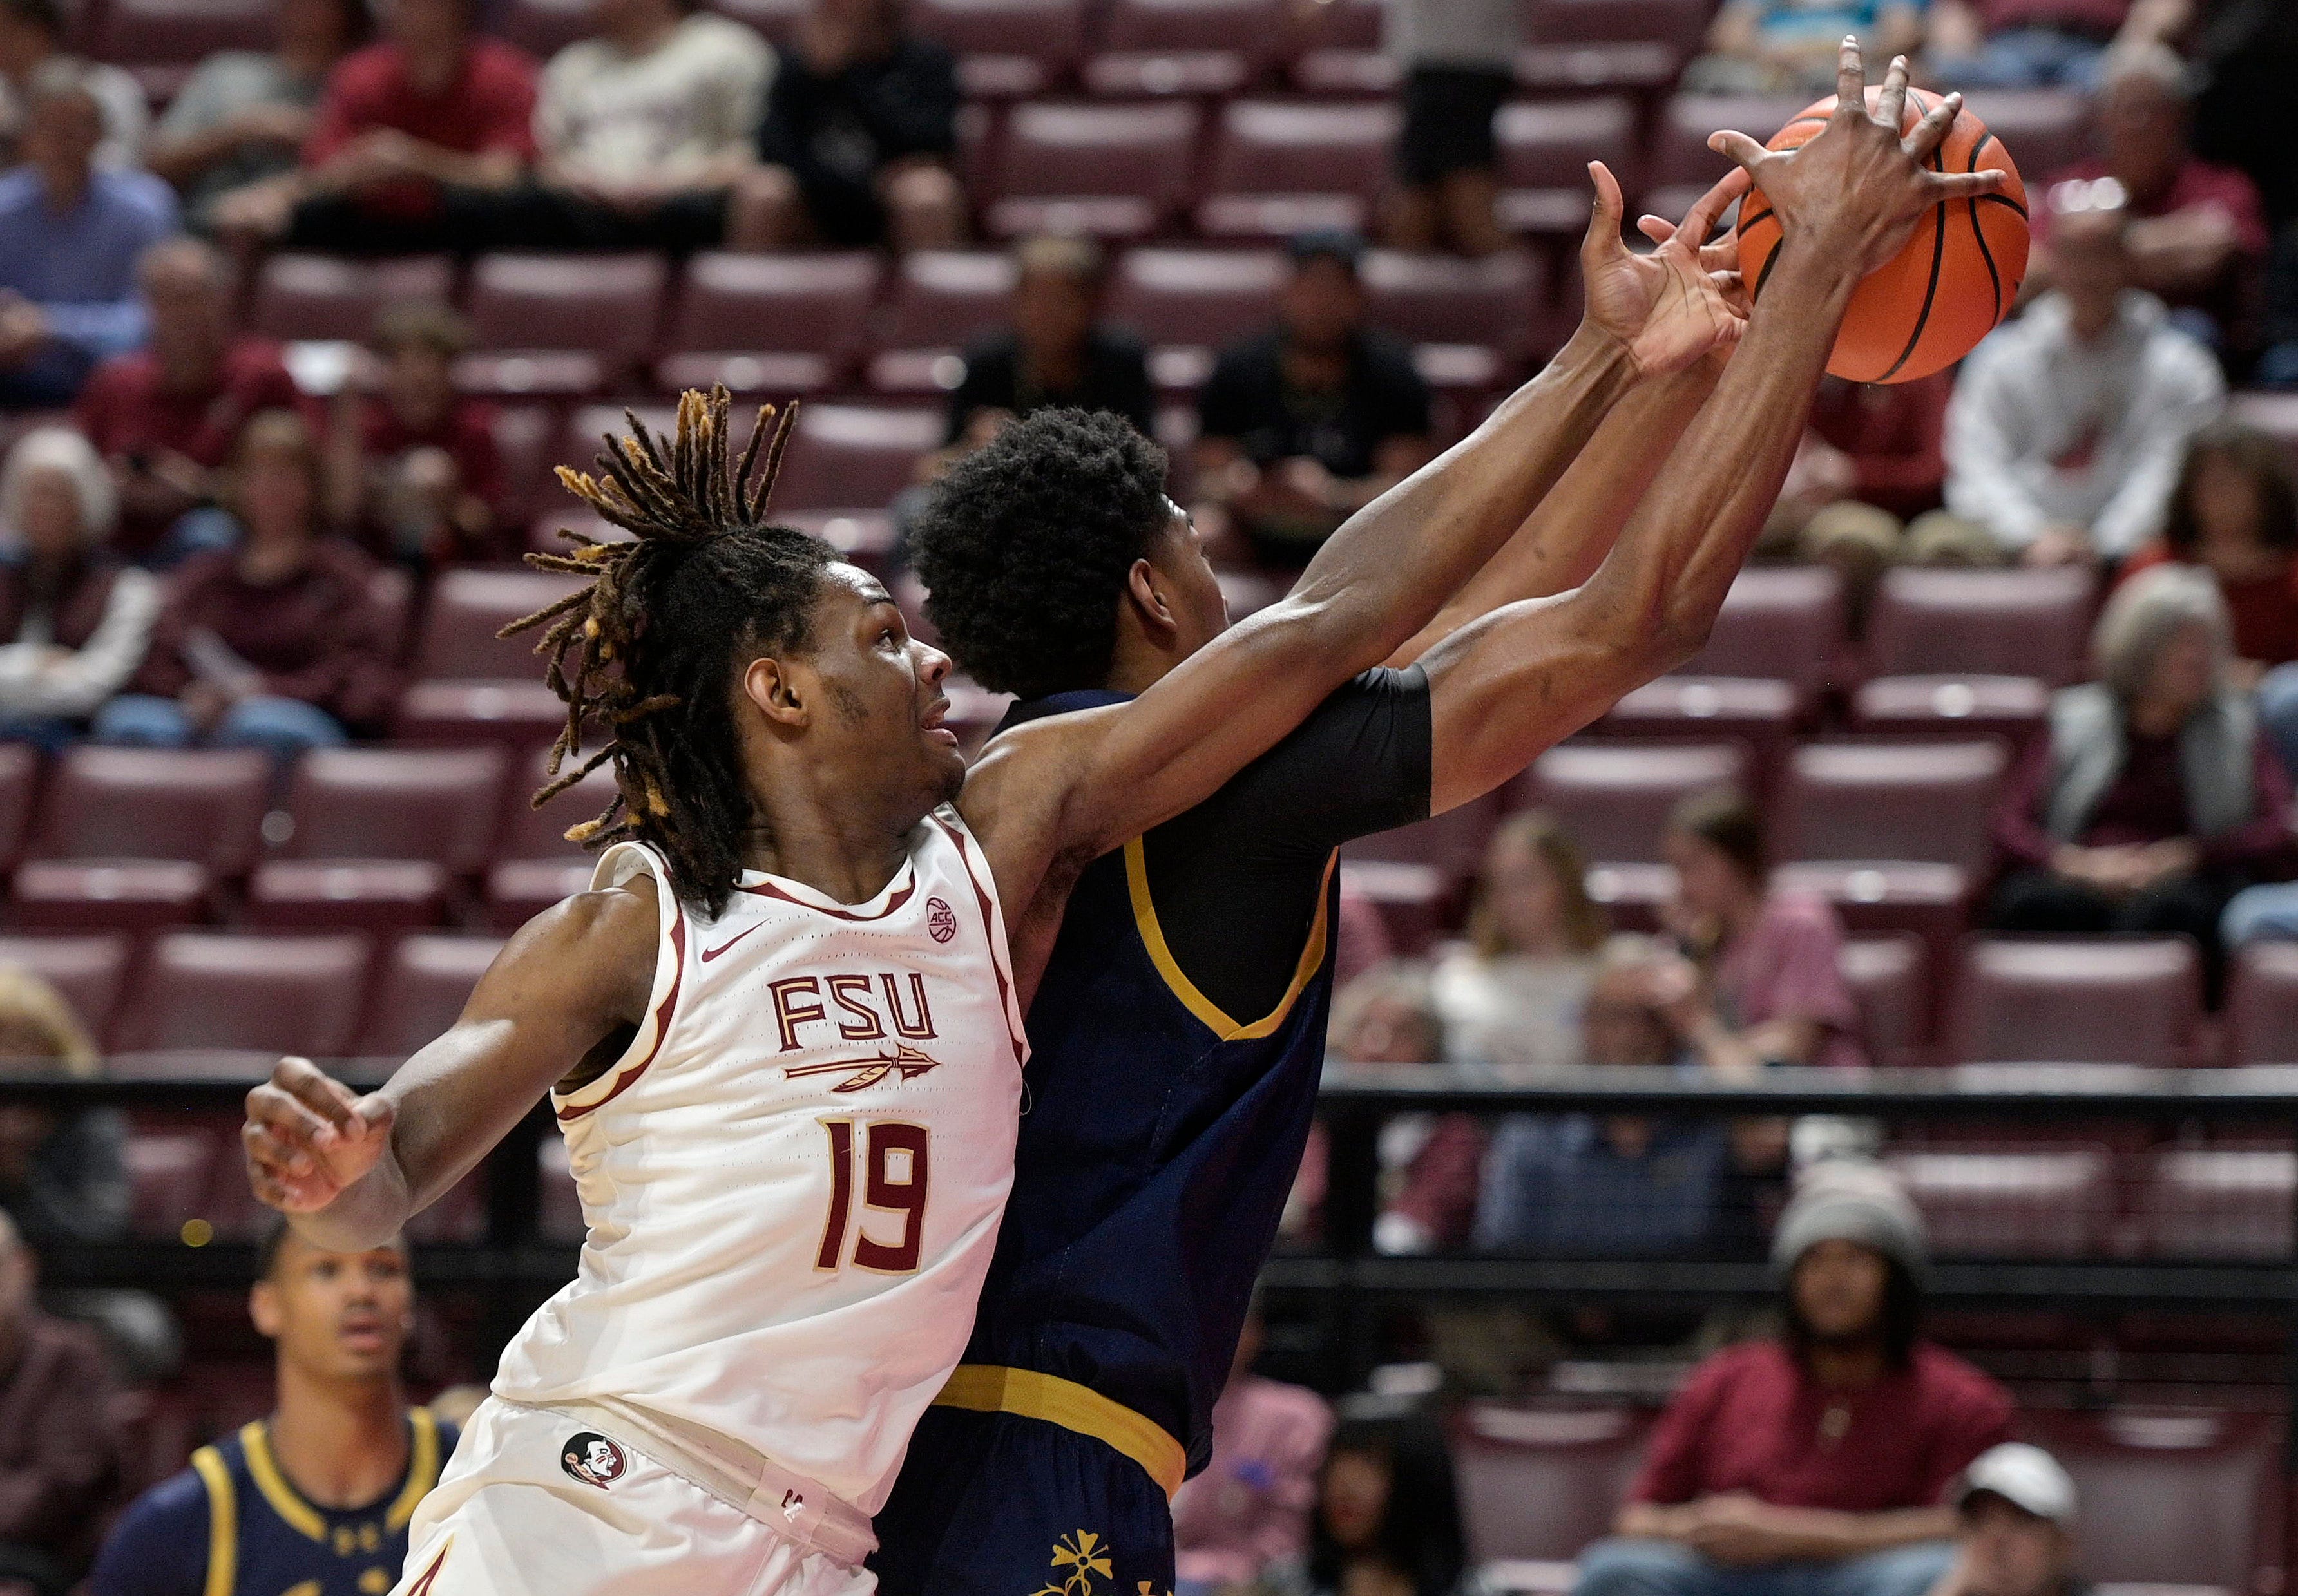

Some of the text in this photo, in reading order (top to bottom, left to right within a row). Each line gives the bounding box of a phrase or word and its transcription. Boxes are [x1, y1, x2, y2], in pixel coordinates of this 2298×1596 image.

[930, 911, 952, 922] ACC
[767, 973, 939, 1052] FSU
[812, 1116, 931, 1276] 19
